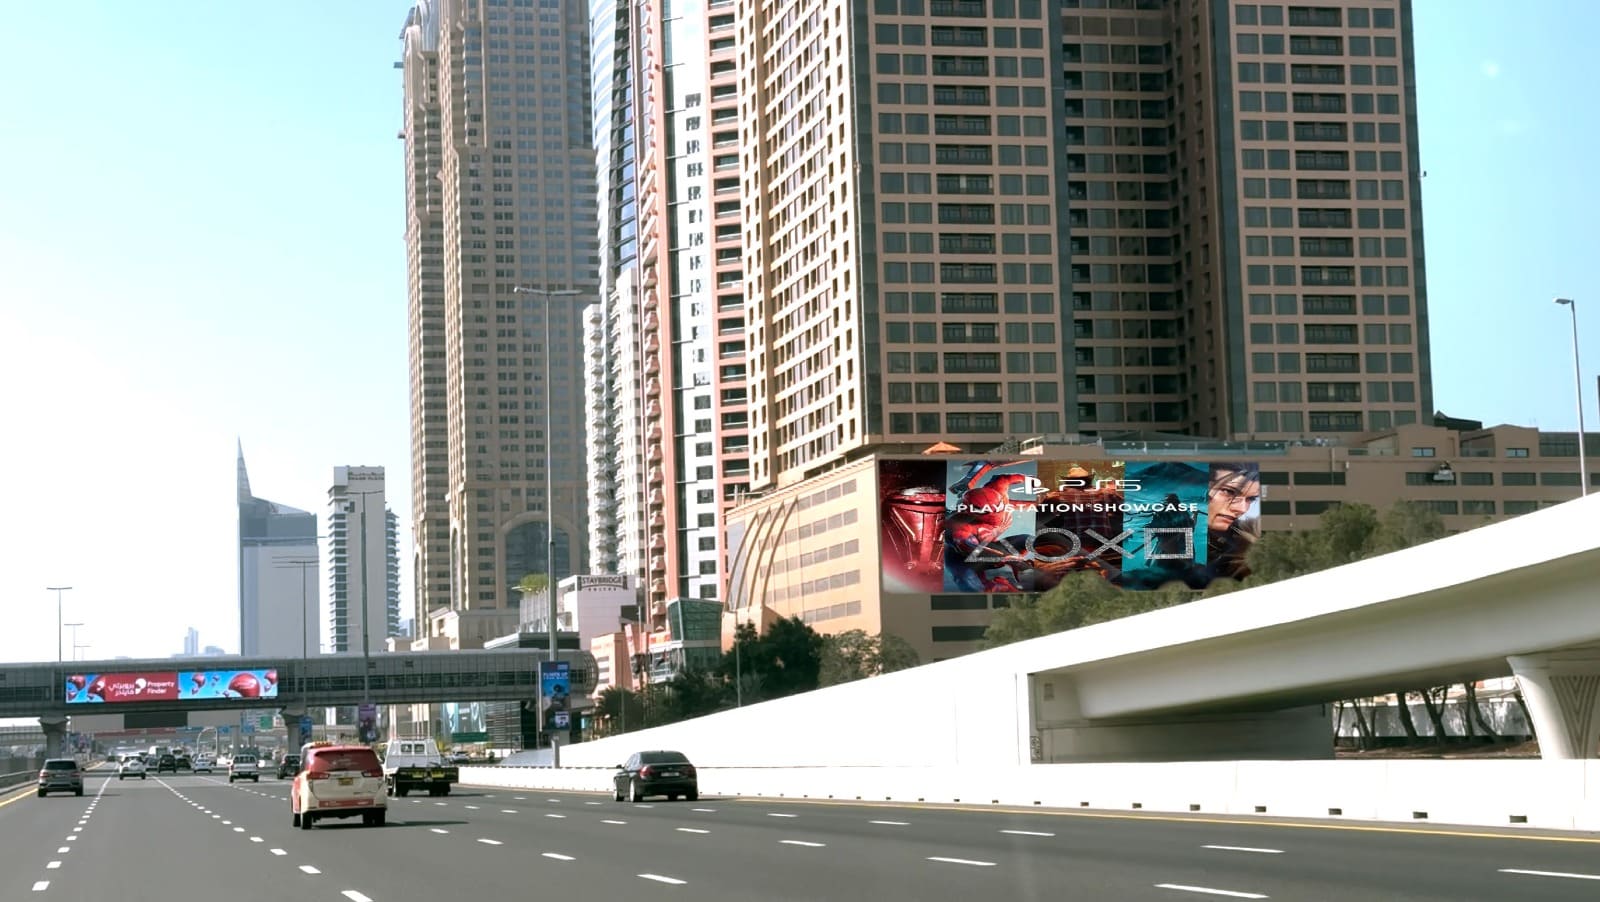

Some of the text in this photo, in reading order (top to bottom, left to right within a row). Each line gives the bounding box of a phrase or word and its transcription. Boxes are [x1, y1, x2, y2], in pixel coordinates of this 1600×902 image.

[1058, 479, 1141, 492] PS5
[957, 502, 1199, 513] PLAYSTATION SHOWCASE
[582, 576, 622, 585] STAYBRIDGE
